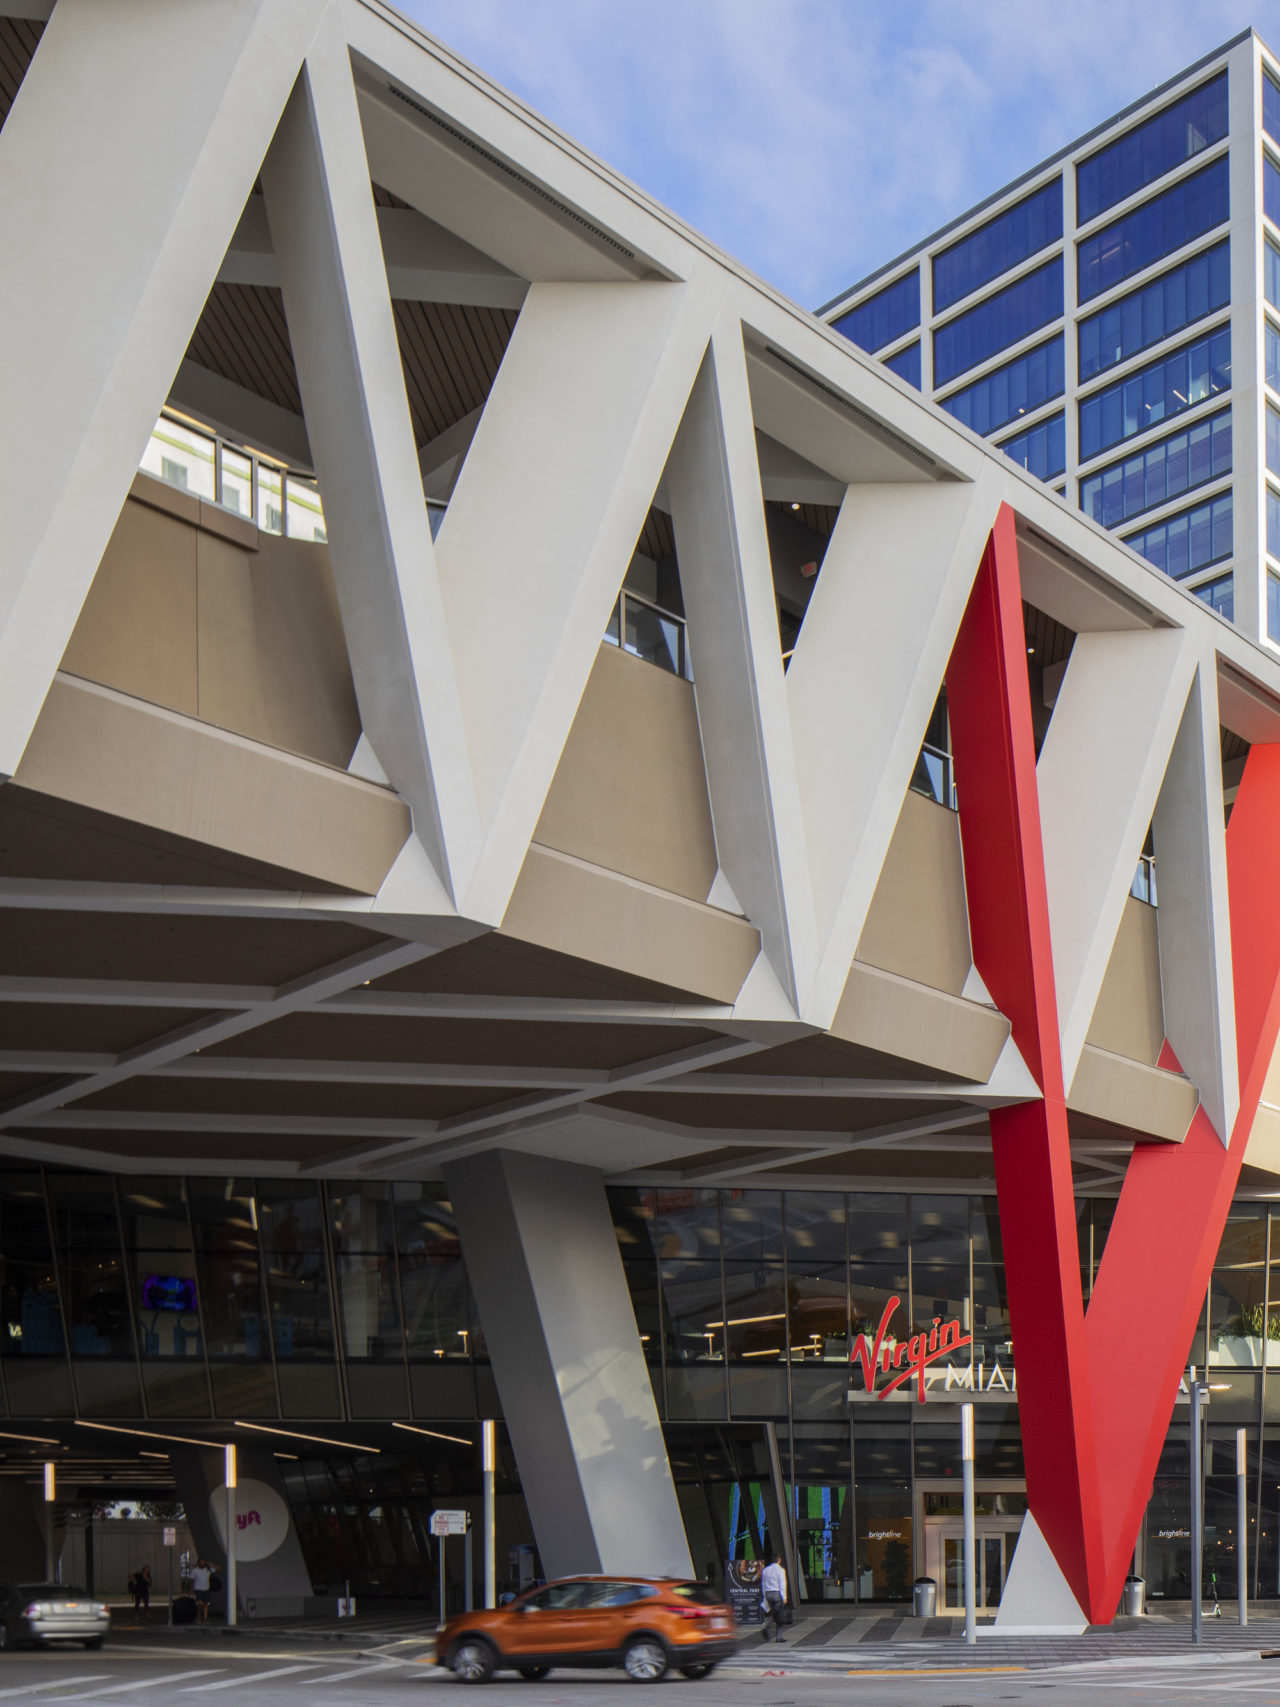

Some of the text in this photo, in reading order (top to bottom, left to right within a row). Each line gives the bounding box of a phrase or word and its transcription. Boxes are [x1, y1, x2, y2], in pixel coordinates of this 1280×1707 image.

[850, 1296, 972, 1403] Virgin
[945, 1363, 1017, 1392] MIA
[868, 1530, 902, 1540] brightline
[1158, 1528, 1190, 1539] brightline
